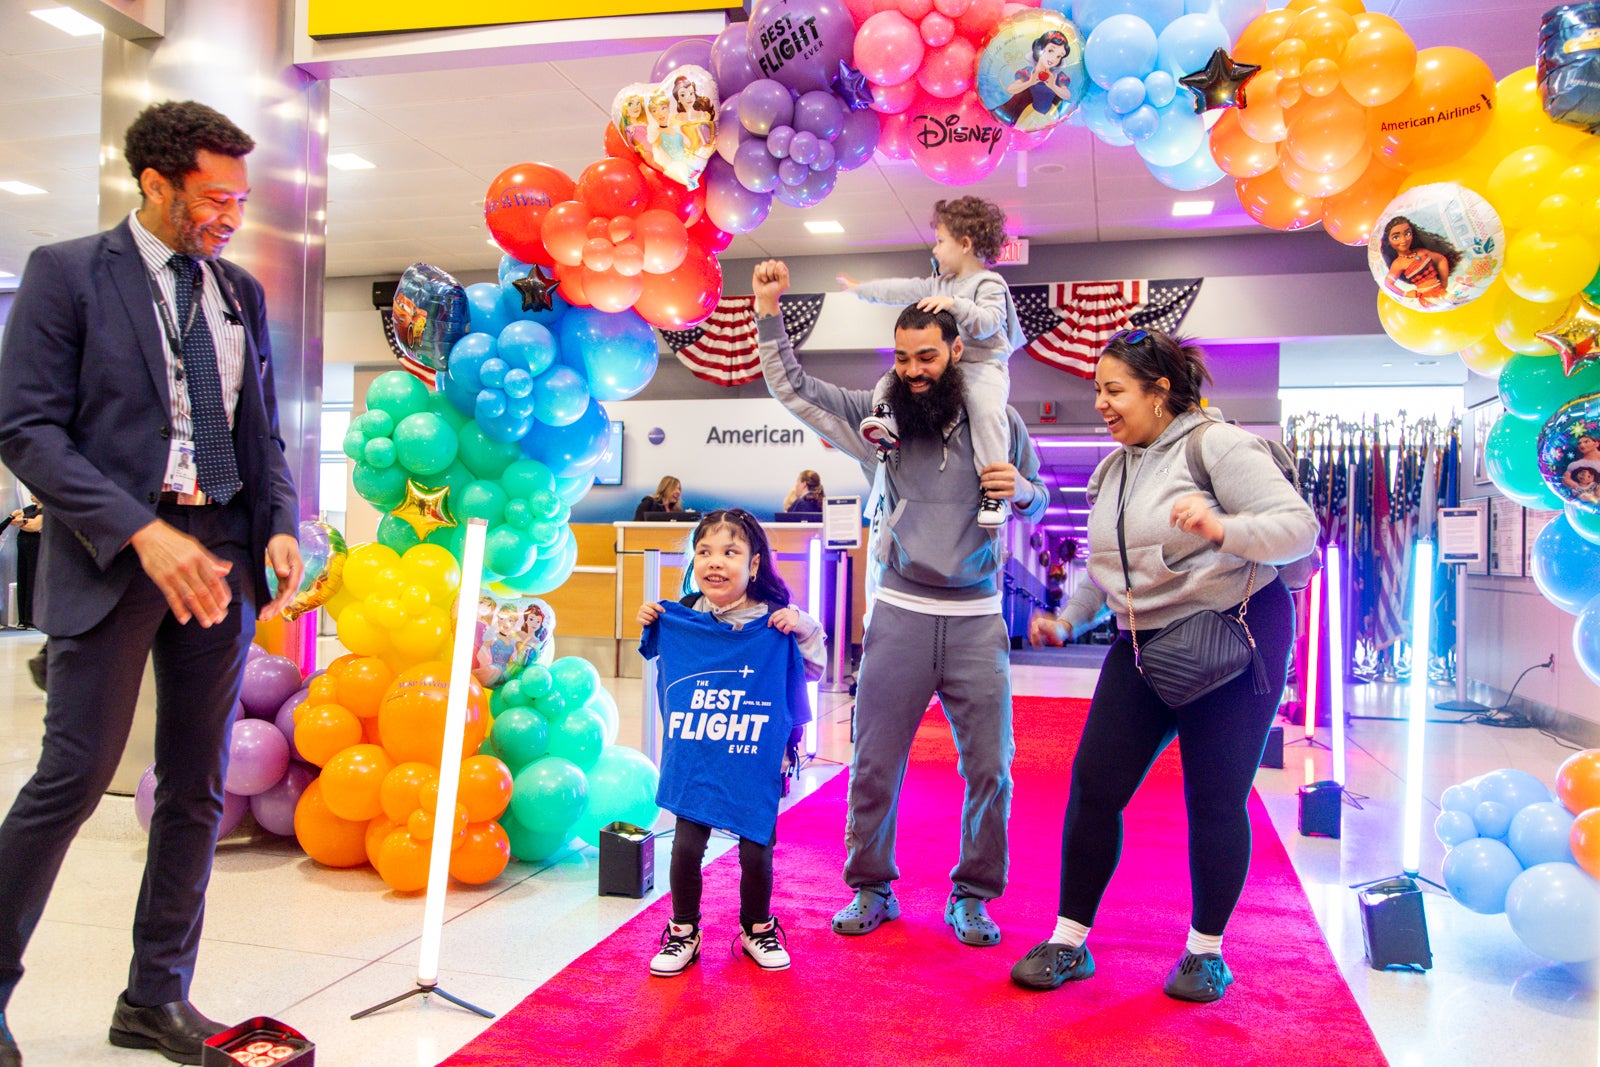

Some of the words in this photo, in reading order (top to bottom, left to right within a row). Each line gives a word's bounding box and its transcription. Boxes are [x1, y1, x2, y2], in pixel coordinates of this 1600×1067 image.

[760, 13, 792, 51] BEST
[758, 15, 819, 79] FLIGHT
[803, 40, 824, 60] EVER
[1381, 115, 1435, 132] American
[1437, 103, 1481, 122] Airlines
[706, 425, 804, 445] American
[690, 689, 746, 711] BEST
[668, 711, 770, 742] FLIGHT
[728, 744, 759, 754] EVER
